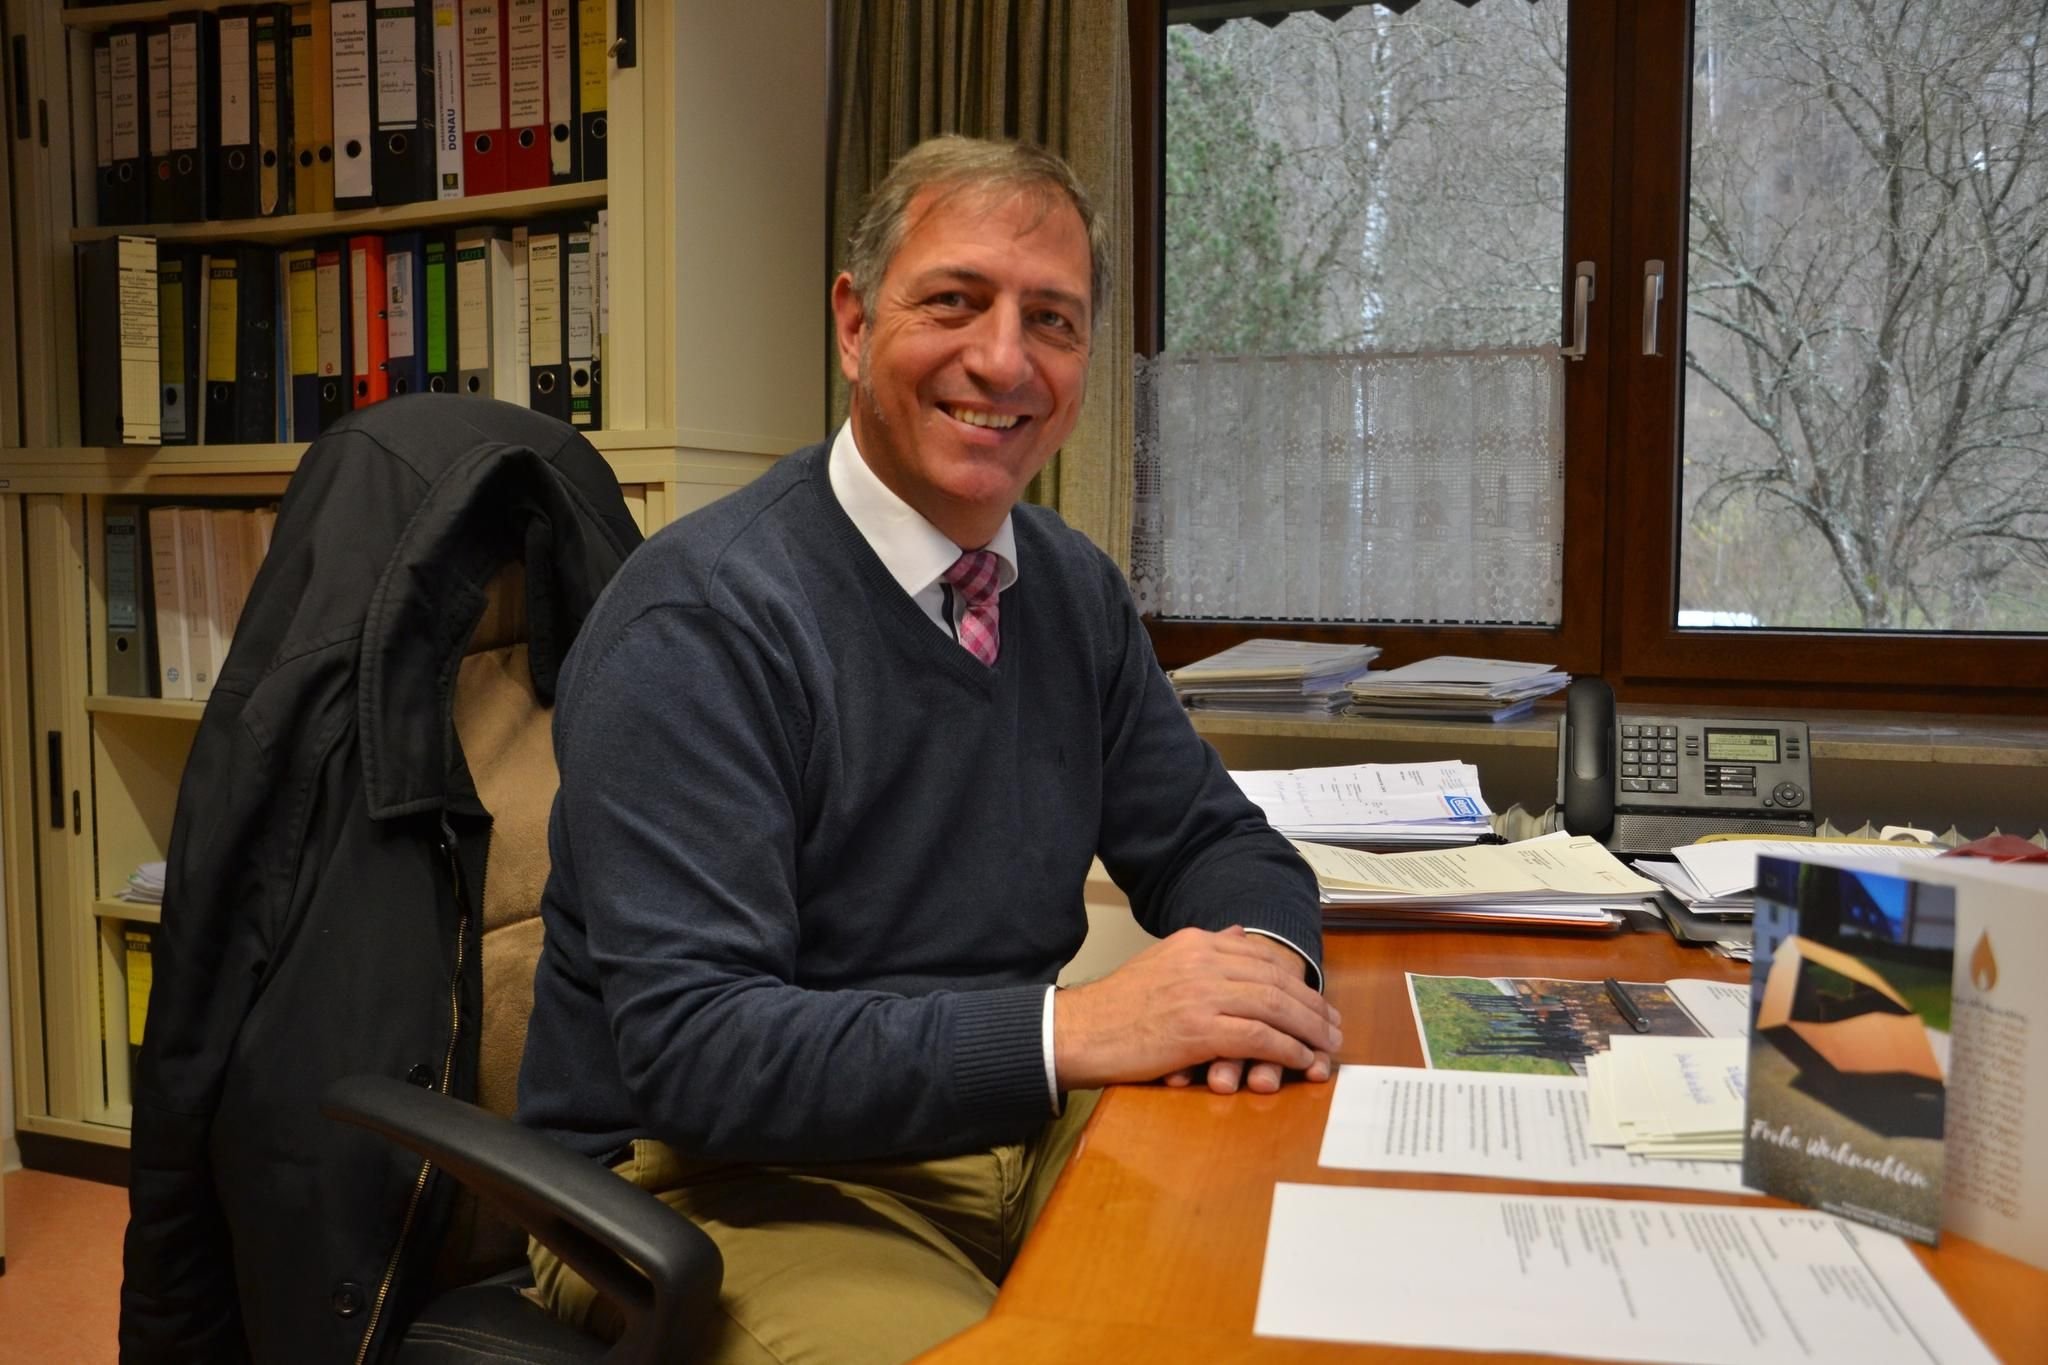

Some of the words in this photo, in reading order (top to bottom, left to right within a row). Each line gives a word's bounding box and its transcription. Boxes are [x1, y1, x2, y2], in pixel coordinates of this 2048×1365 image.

[447, 108, 456, 151] DONAU
[213, 269, 234, 278] LEITZ
[1750, 1118, 1801, 1150] Frohe
[1805, 1136, 1929, 1188] Weihnachten
